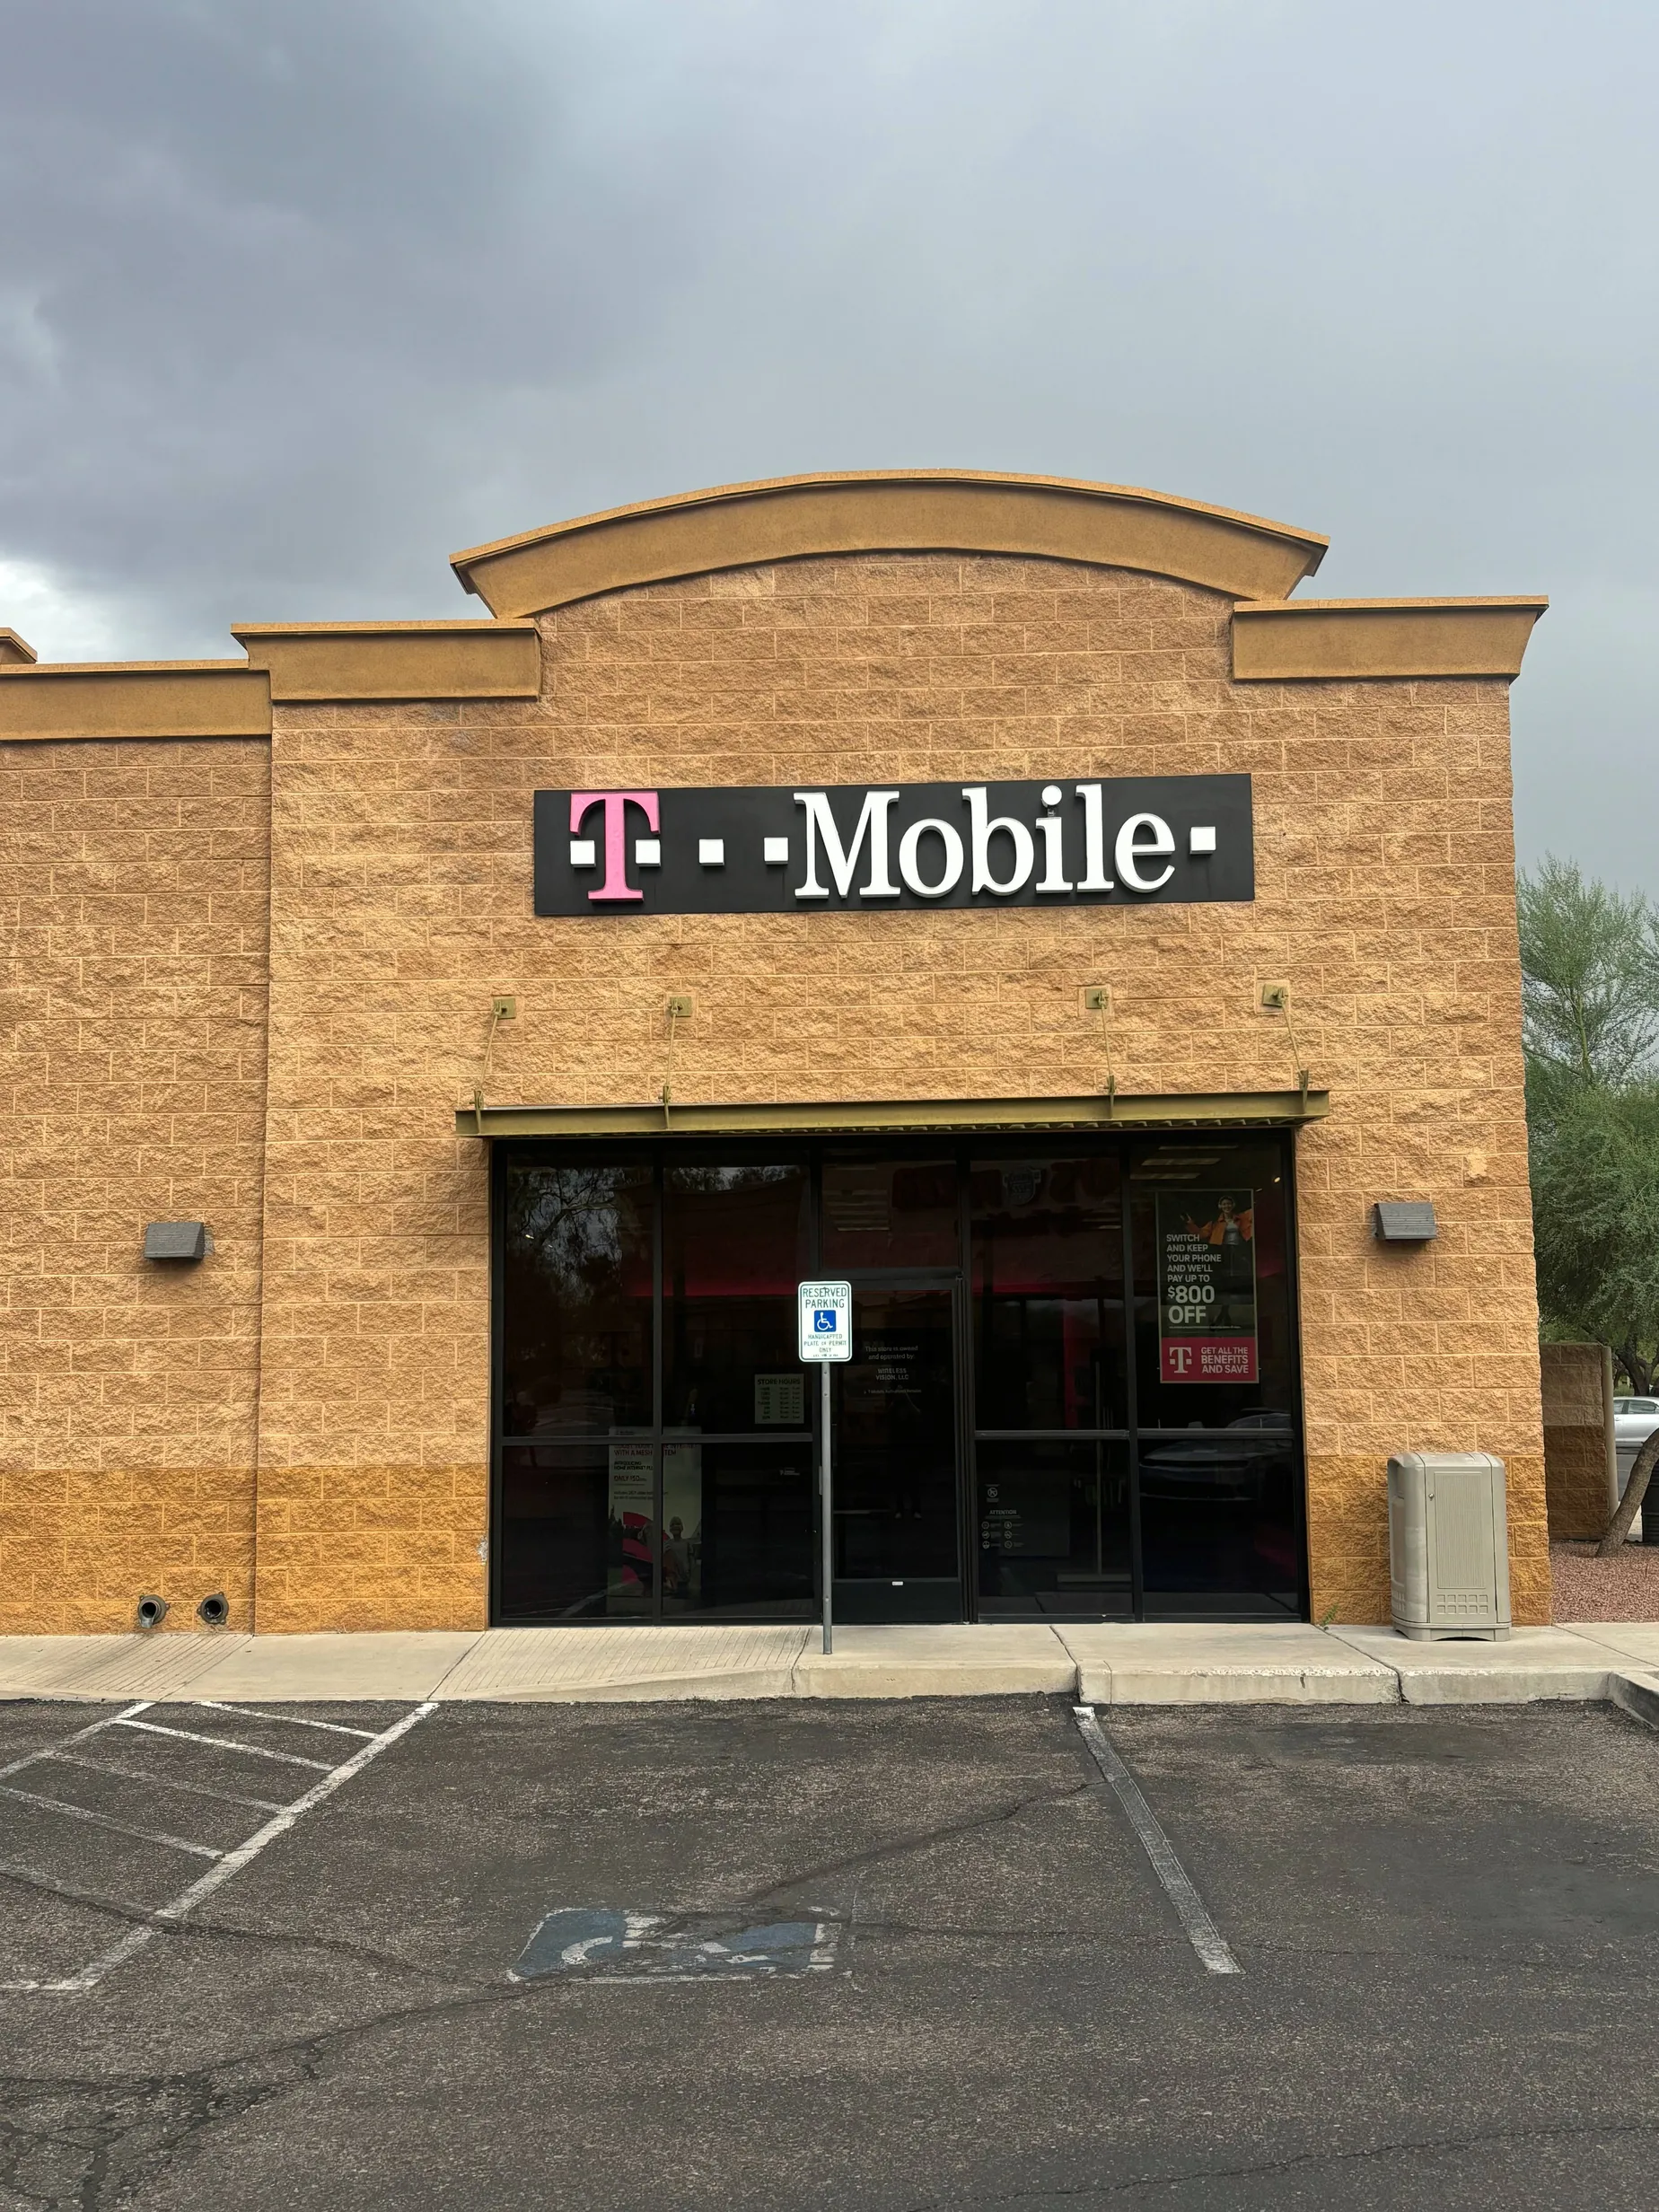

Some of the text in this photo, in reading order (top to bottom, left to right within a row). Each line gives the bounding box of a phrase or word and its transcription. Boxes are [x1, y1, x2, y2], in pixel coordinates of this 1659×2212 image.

[794, 783, 1176, 900] Mobile
[1166, 1233, 1200, 1242] SWITCH
[1166, 1244, 1208, 1252] AND KEEP
[1167, 1254, 1222, 1262] YOUR PHONE
[1167, 1264, 1214, 1272] AND WE'LL
[1167, 1274, 1210, 1283] PAY UP TO
[803, 1287, 847, 1298] RESERVED
[1167, 1285, 1216, 1304] $800
[805, 1298, 845, 1309] PARKING
[1168, 1305, 1207, 1324] OFF
[1201, 1347, 1249, 1355] GET ALL THE
[1201, 1355, 1249, 1365] BENEFITS
[1201, 1365, 1250, 1374] AND SAVE
